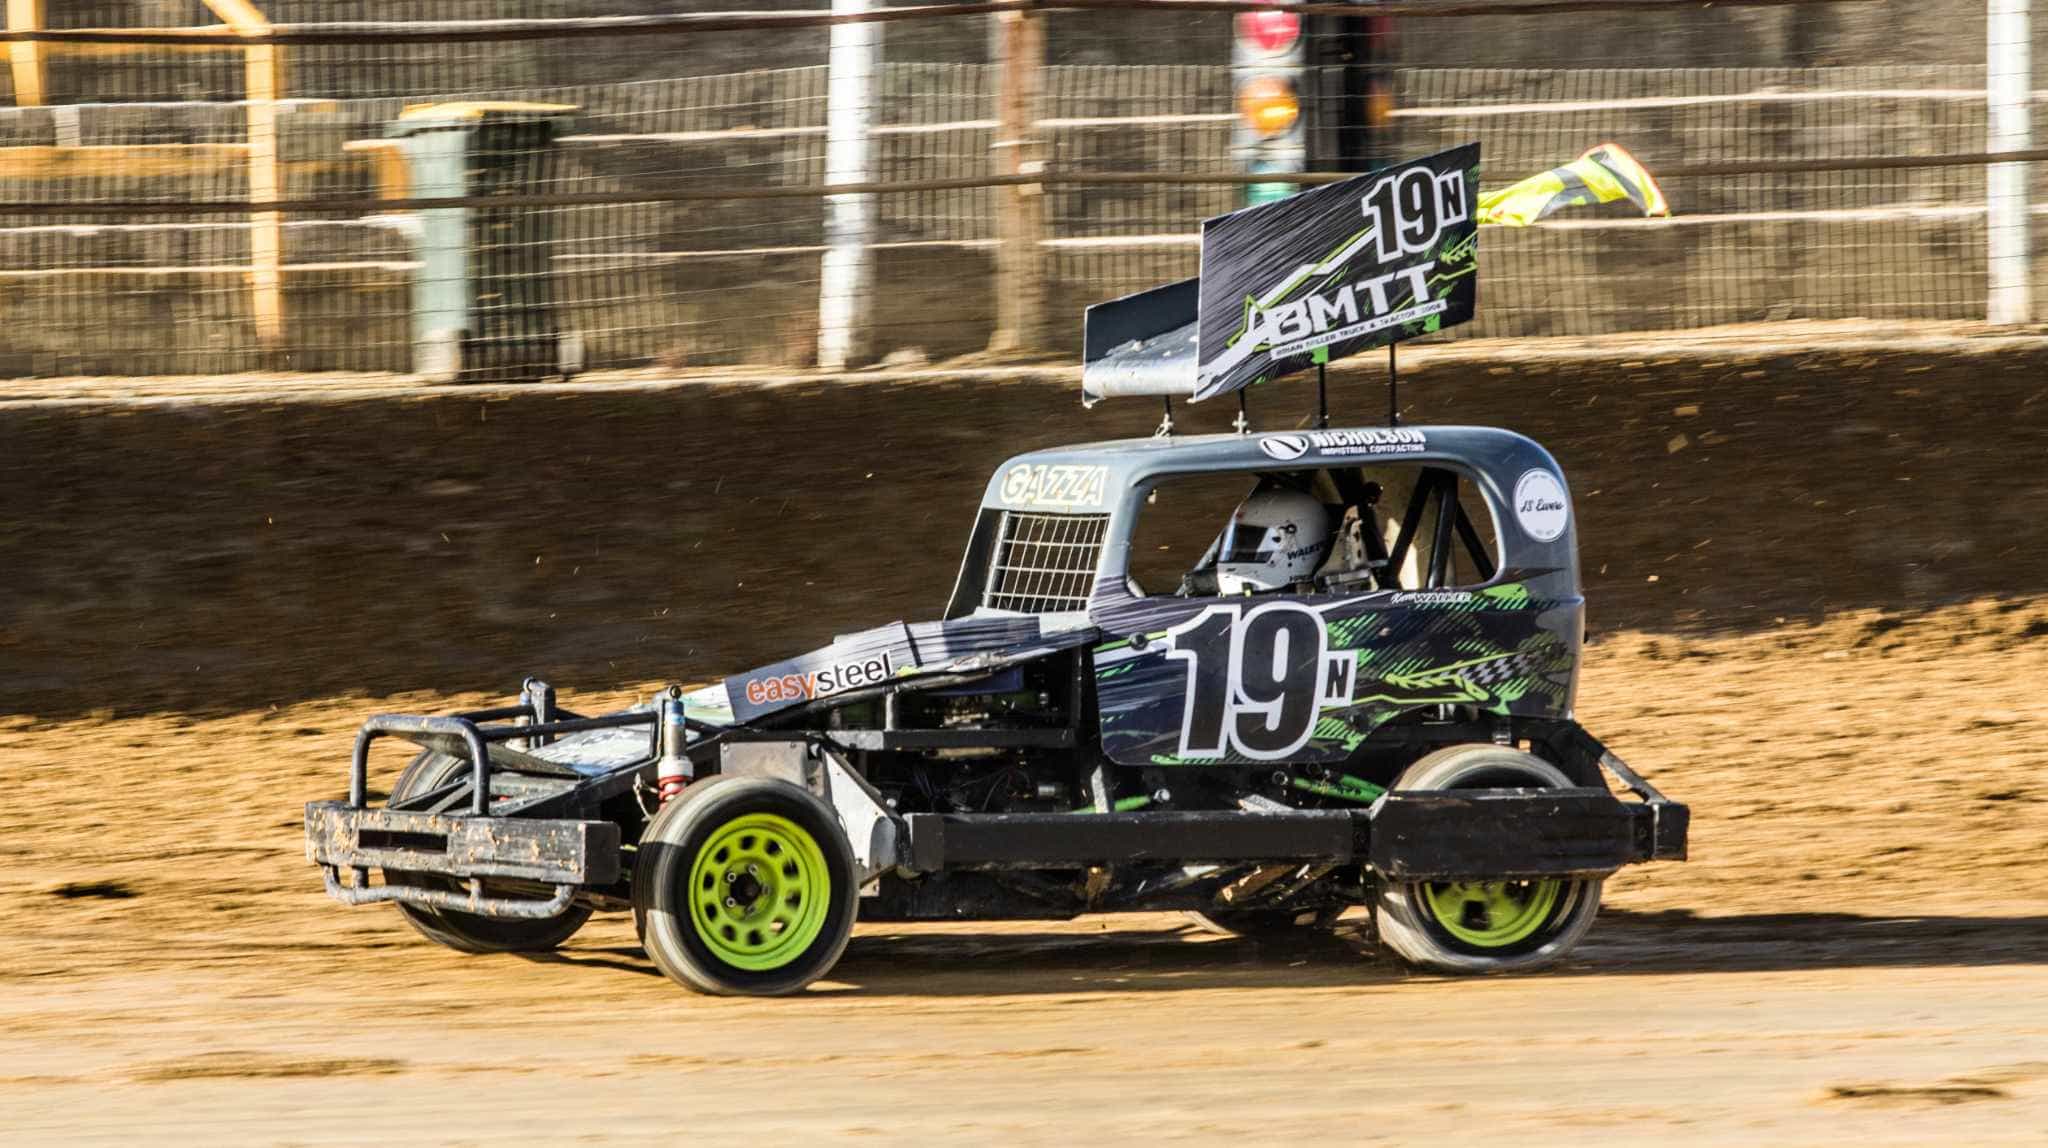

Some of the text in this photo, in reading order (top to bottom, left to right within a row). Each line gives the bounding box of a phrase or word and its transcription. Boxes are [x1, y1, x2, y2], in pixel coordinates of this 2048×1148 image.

[1268, 261, 1436, 344] BMTT
[1340, 324, 1368, 338] TRUCK
[1310, 430, 1427, 448] NICHOLSON
[1369, 443, 1425, 455] CONTRACTING
[1000, 464, 1109, 506] GAZZA
[746, 650, 895, 704] easysteel
